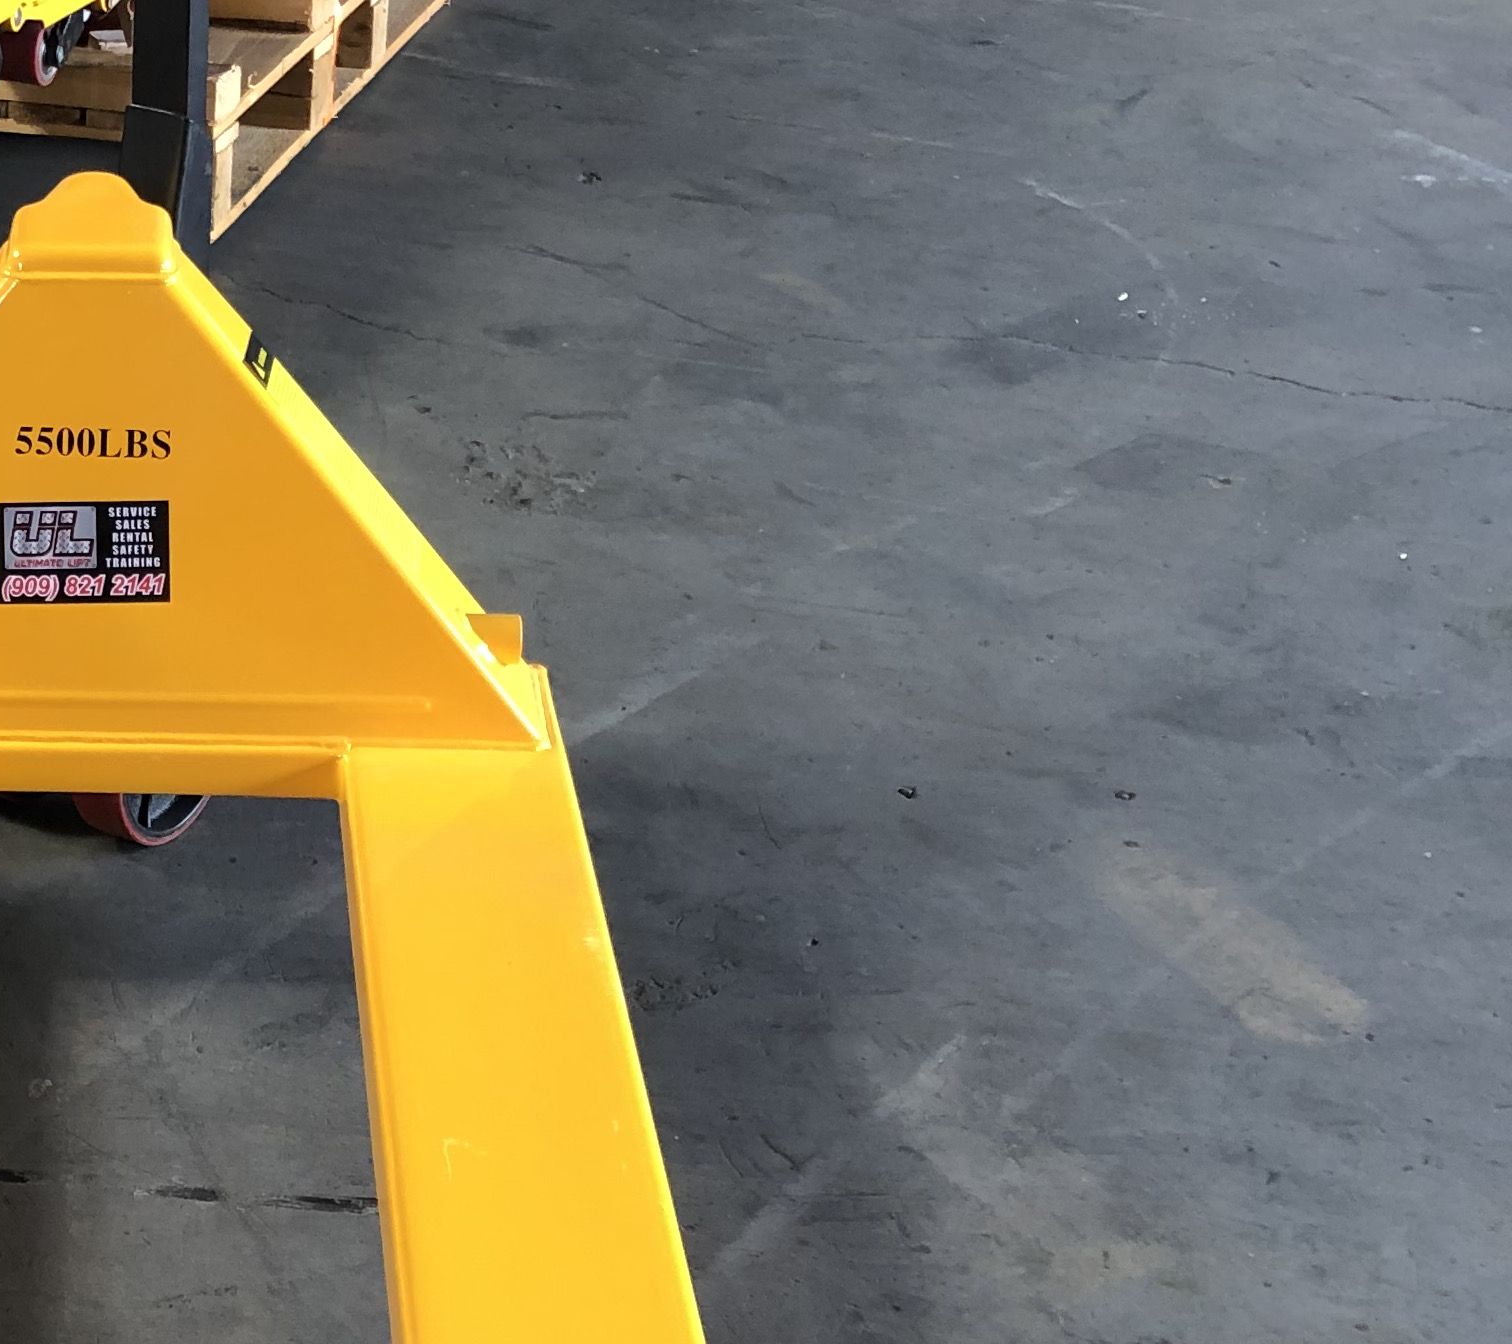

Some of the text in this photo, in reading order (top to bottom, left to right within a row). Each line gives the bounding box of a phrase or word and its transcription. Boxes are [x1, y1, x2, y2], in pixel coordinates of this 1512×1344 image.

[14, 426, 171, 459] 5500LBS
[108, 506, 157, 517] SERVICE
[115, 519, 150, 530] SALES
[10, 511, 94, 557] UL
[112, 532, 154, 542] RENTAL
[112, 544, 154, 555] SAFETY
[105, 557, 161, 568] TRAINING
[2, 573, 166, 601] (909) 821 2141
